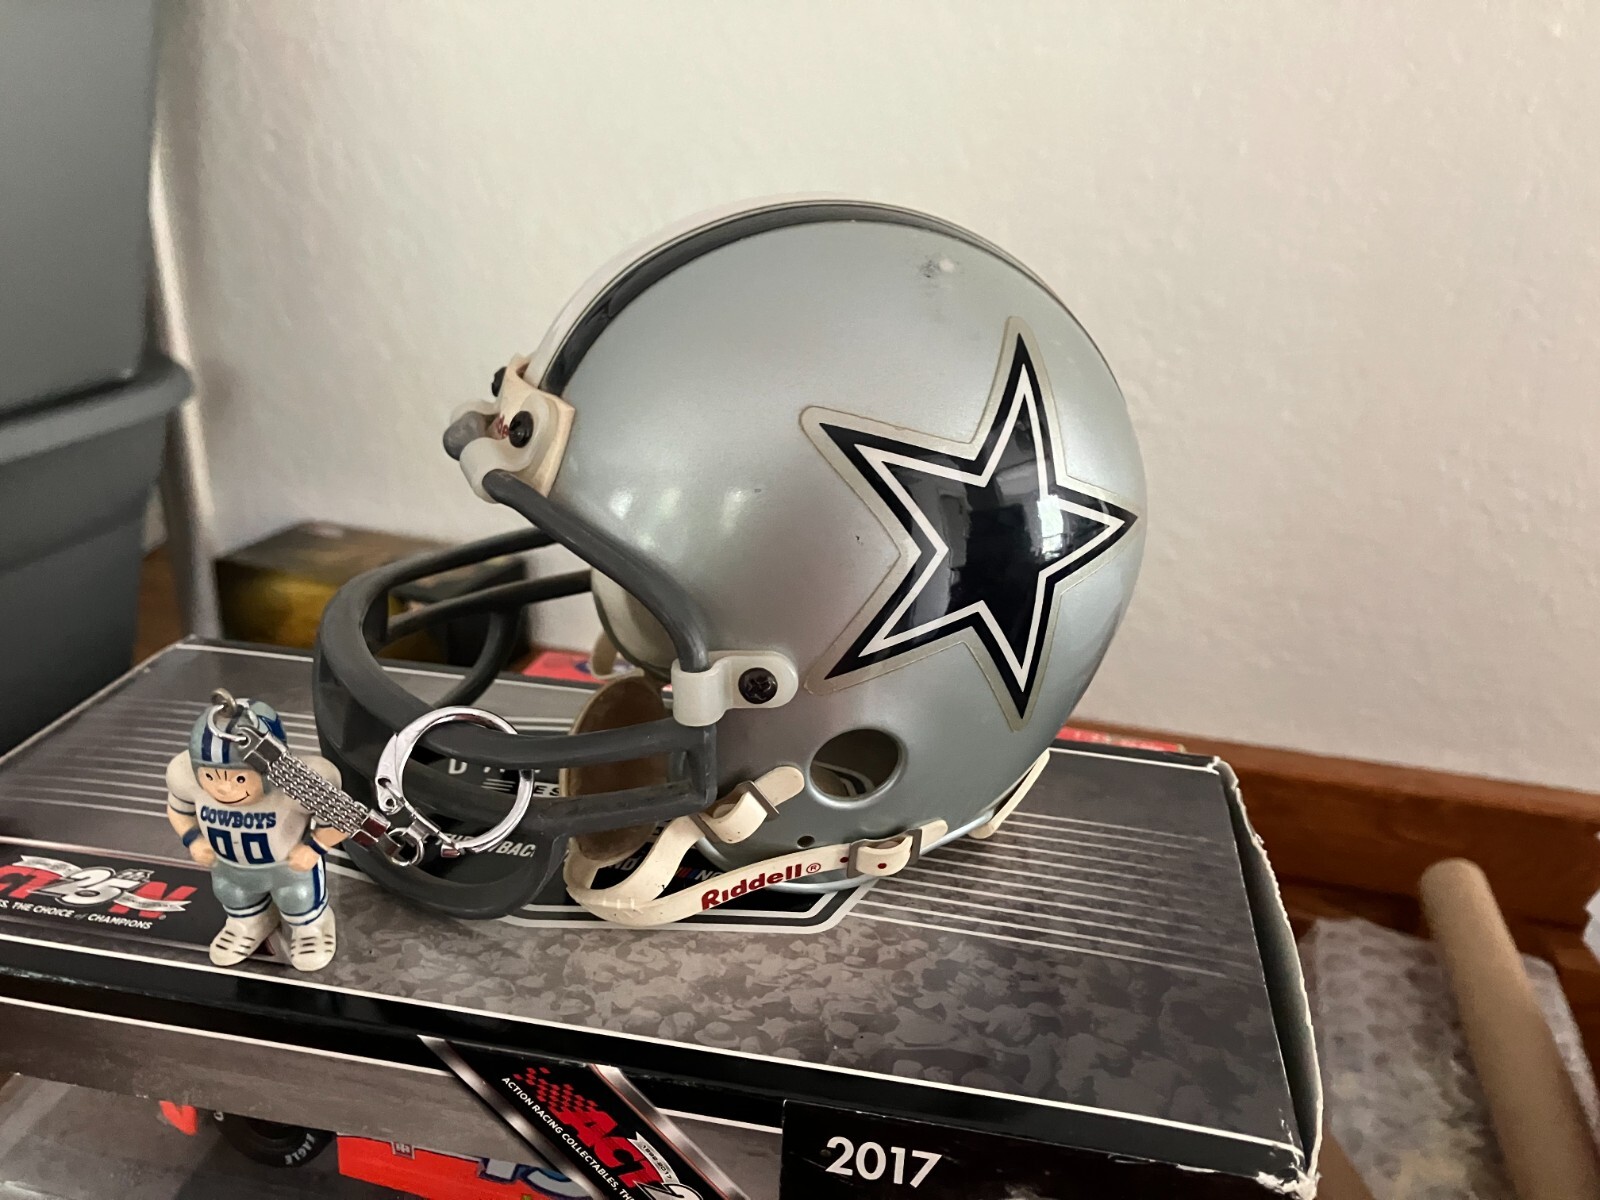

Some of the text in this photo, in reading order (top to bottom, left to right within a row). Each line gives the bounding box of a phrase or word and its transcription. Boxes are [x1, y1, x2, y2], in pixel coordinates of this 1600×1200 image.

[200, 806, 277, 829] COWBOYS
[206, 826, 276, 865] 00
[12, 901, 34, 912] THE
[33, 905, 75, 918] CHOICE
[87, 913, 153, 930] CHAMPIONS
[501, 1077, 534, 1106] ACTION
[531, 1104, 563, 1134] RACING
[561, 1133, 619, 1191] COLLECTABLES,
[825, 1136, 943, 1188] 2017
